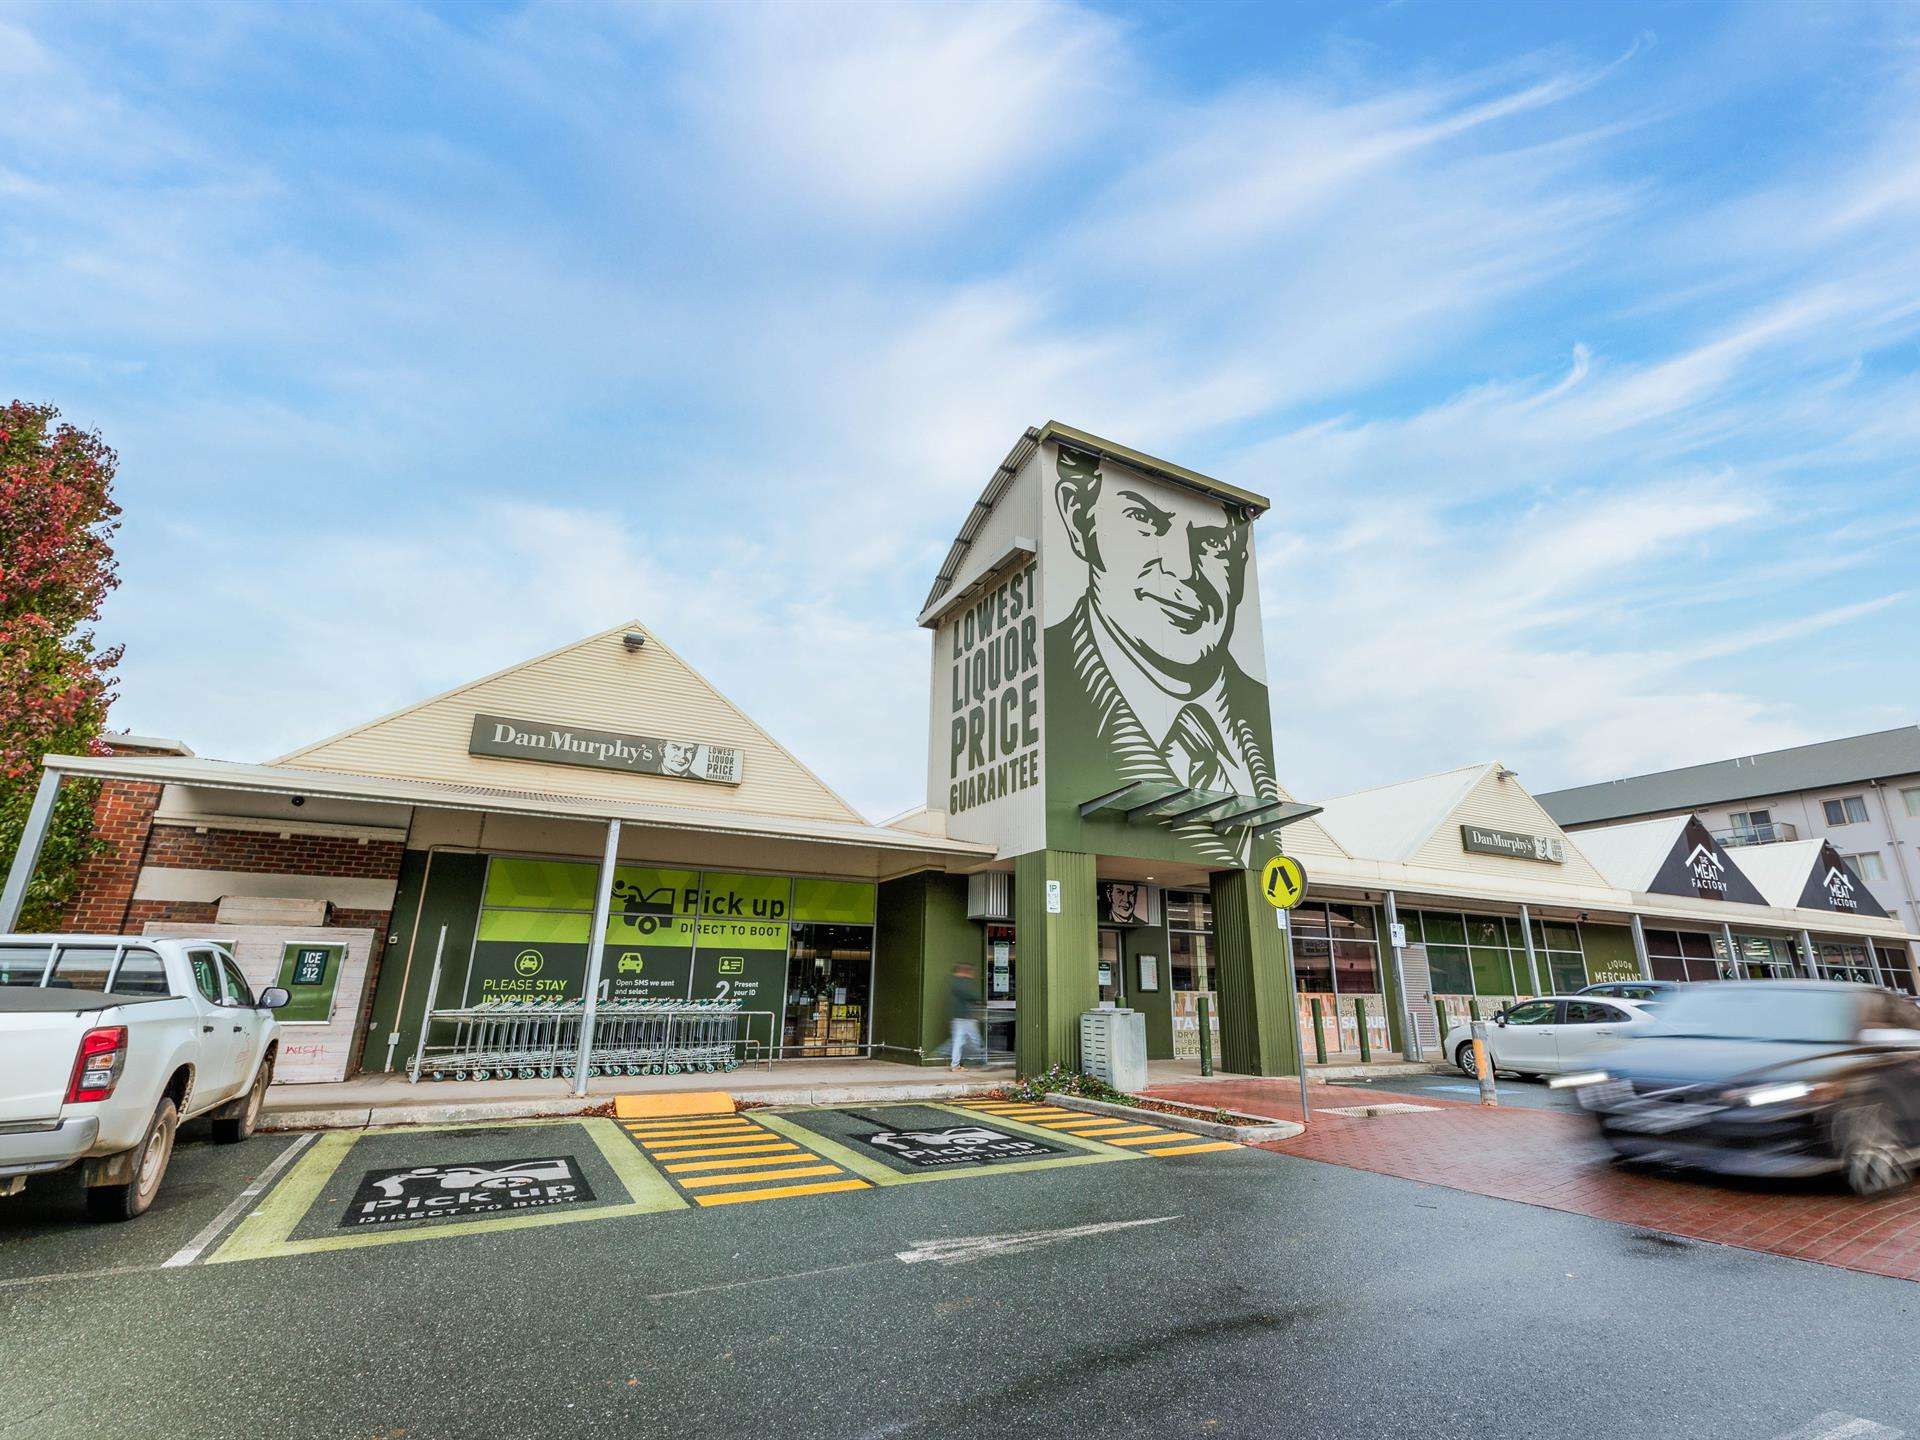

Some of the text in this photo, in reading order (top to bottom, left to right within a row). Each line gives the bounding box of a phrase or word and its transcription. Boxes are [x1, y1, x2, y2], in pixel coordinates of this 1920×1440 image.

[953, 560, 1037, 660] LOWEST
[952, 615, 1038, 714] LIQUOR
[951, 673, 1039, 779] PRICE
[492, 723, 653, 764] Dan Murphy's
[708, 746, 735, 756] LOWEST
[708, 754, 735, 765] LIQUOR
[706, 763, 734, 775] PRICE
[949, 749, 1039, 815] GUARANTEE
[1472, 830, 1493, 845] Dan
[1492, 833, 1533, 853] Murphy's
[1692, 863, 1719, 881] MEAT
[1691, 878, 1728, 892] FACTORY
[1829, 884, 1851, 899] MEAT
[682, 889, 785, 920] Pick up
[1829, 896, 1858, 909] FACTORY
[680, 923, 782, 937] DIRECT TO BOOT
[304, 952, 323, 964] ICE
[1606, 960, 1633, 970] LIQUOR
[302, 967, 320, 979] $12
[483, 979, 568, 991] PLEASE STAY
[615, 979, 634, 987] Open
[716, 980, 730, 1001] 2
[898, 1140, 1036, 1159] Pick up
[361, 1184, 577, 1213] Pick up
[358, 1195, 578, 1224] DIRECT TO BOOT
